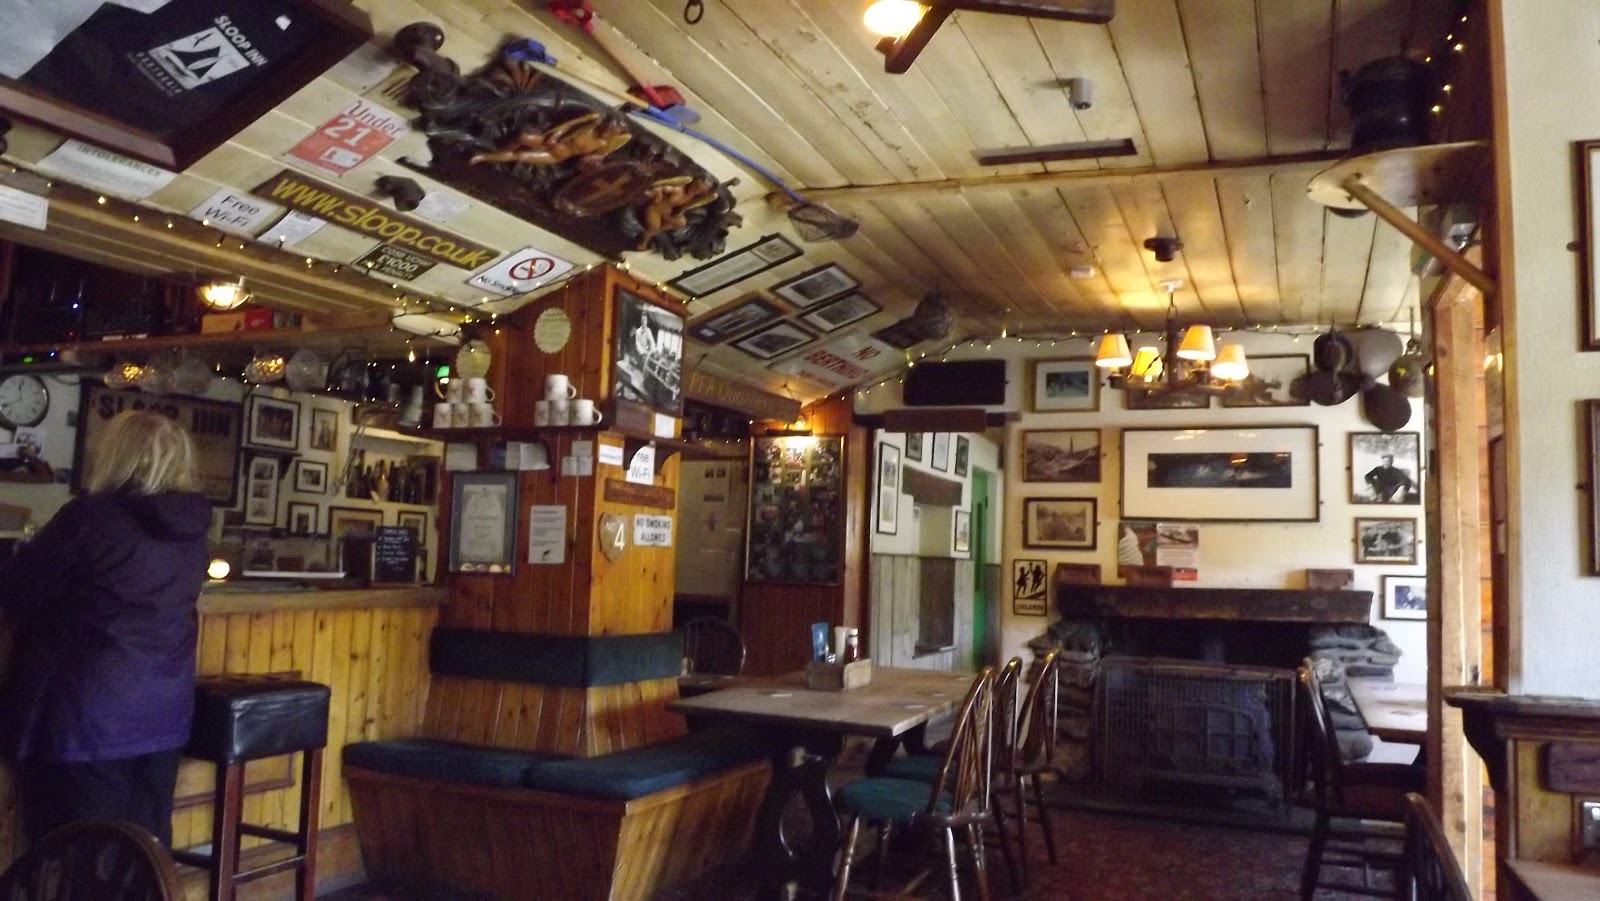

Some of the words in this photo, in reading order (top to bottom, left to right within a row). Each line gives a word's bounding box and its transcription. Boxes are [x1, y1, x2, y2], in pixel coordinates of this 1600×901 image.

[214, 15, 252, 50] SLOOP
[245, 48, 268, 67] INN
[323, 117, 372, 147] 21
[350, 102, 404, 135] Under
[204, 207, 252, 227] Wi-Fi
[221, 194, 260, 215] Free
[271, 178, 491, 268] www.sloop.co.uk
[614, 522, 625, 551] 4
[636, 518, 645, 528] NO
[645, 518, 672, 530] SMOKING
